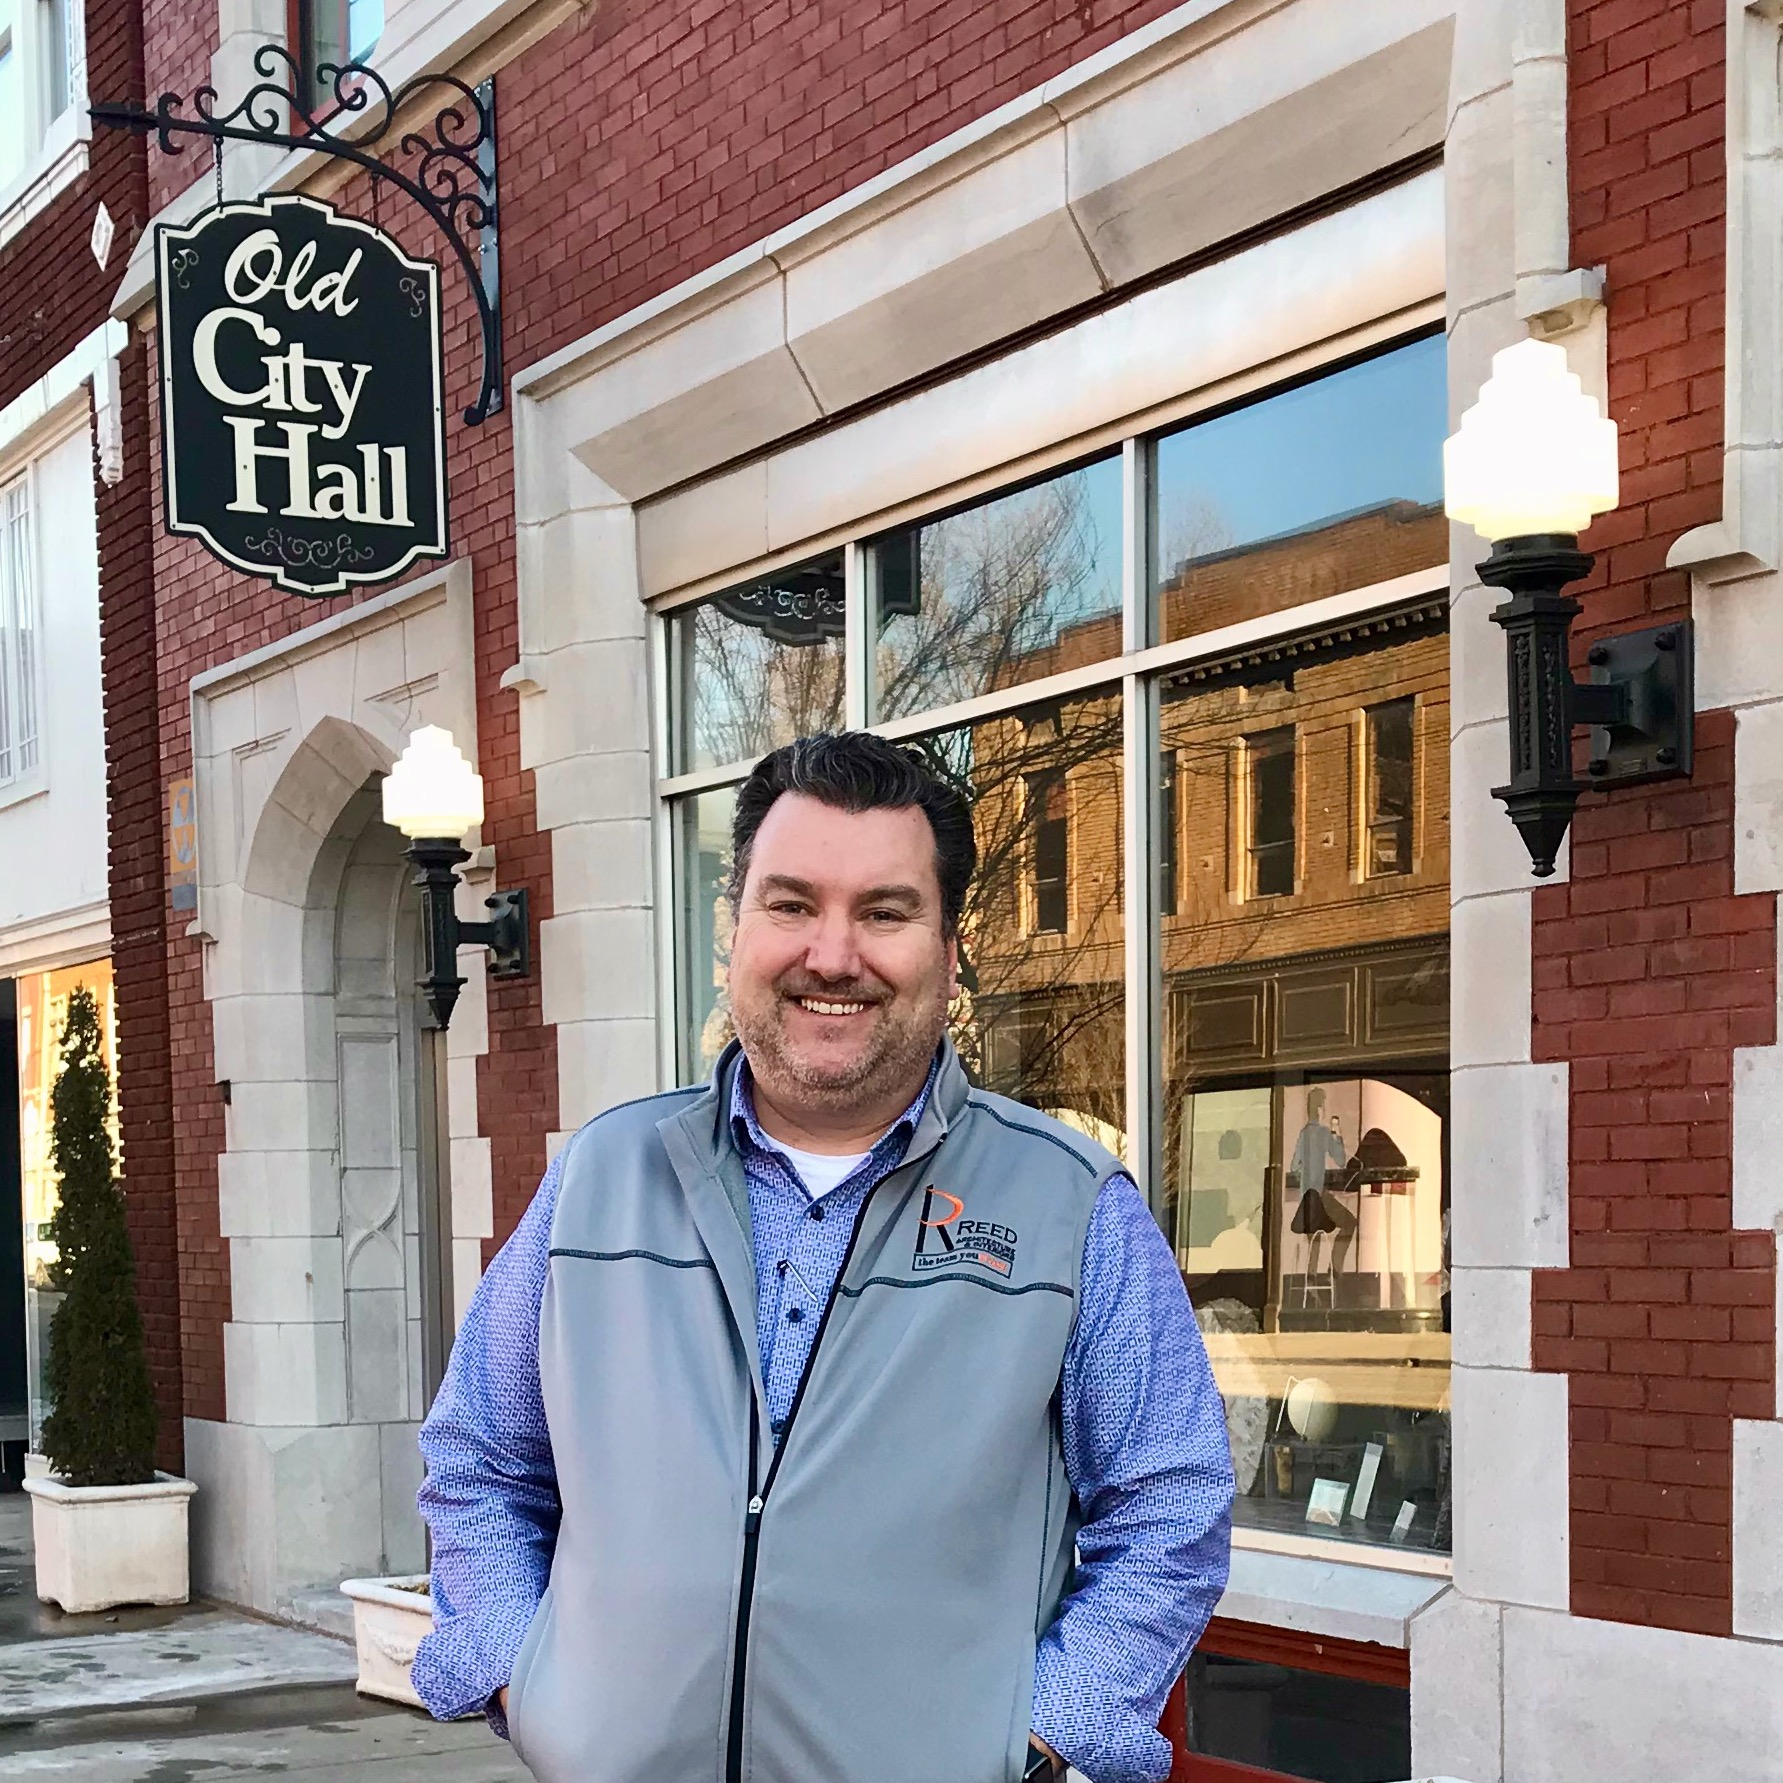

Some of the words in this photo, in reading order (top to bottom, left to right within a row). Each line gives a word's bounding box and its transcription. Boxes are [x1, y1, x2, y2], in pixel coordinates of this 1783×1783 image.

[224, 228, 363, 317] Old
[192, 306, 373, 440] City
[222, 415, 415, 528] Hall
[918, 1257, 934, 1267] the
[936, 1254, 957, 1264] team
[960, 1252, 978, 1261] you
[957, 1220, 1018, 1244] REED
